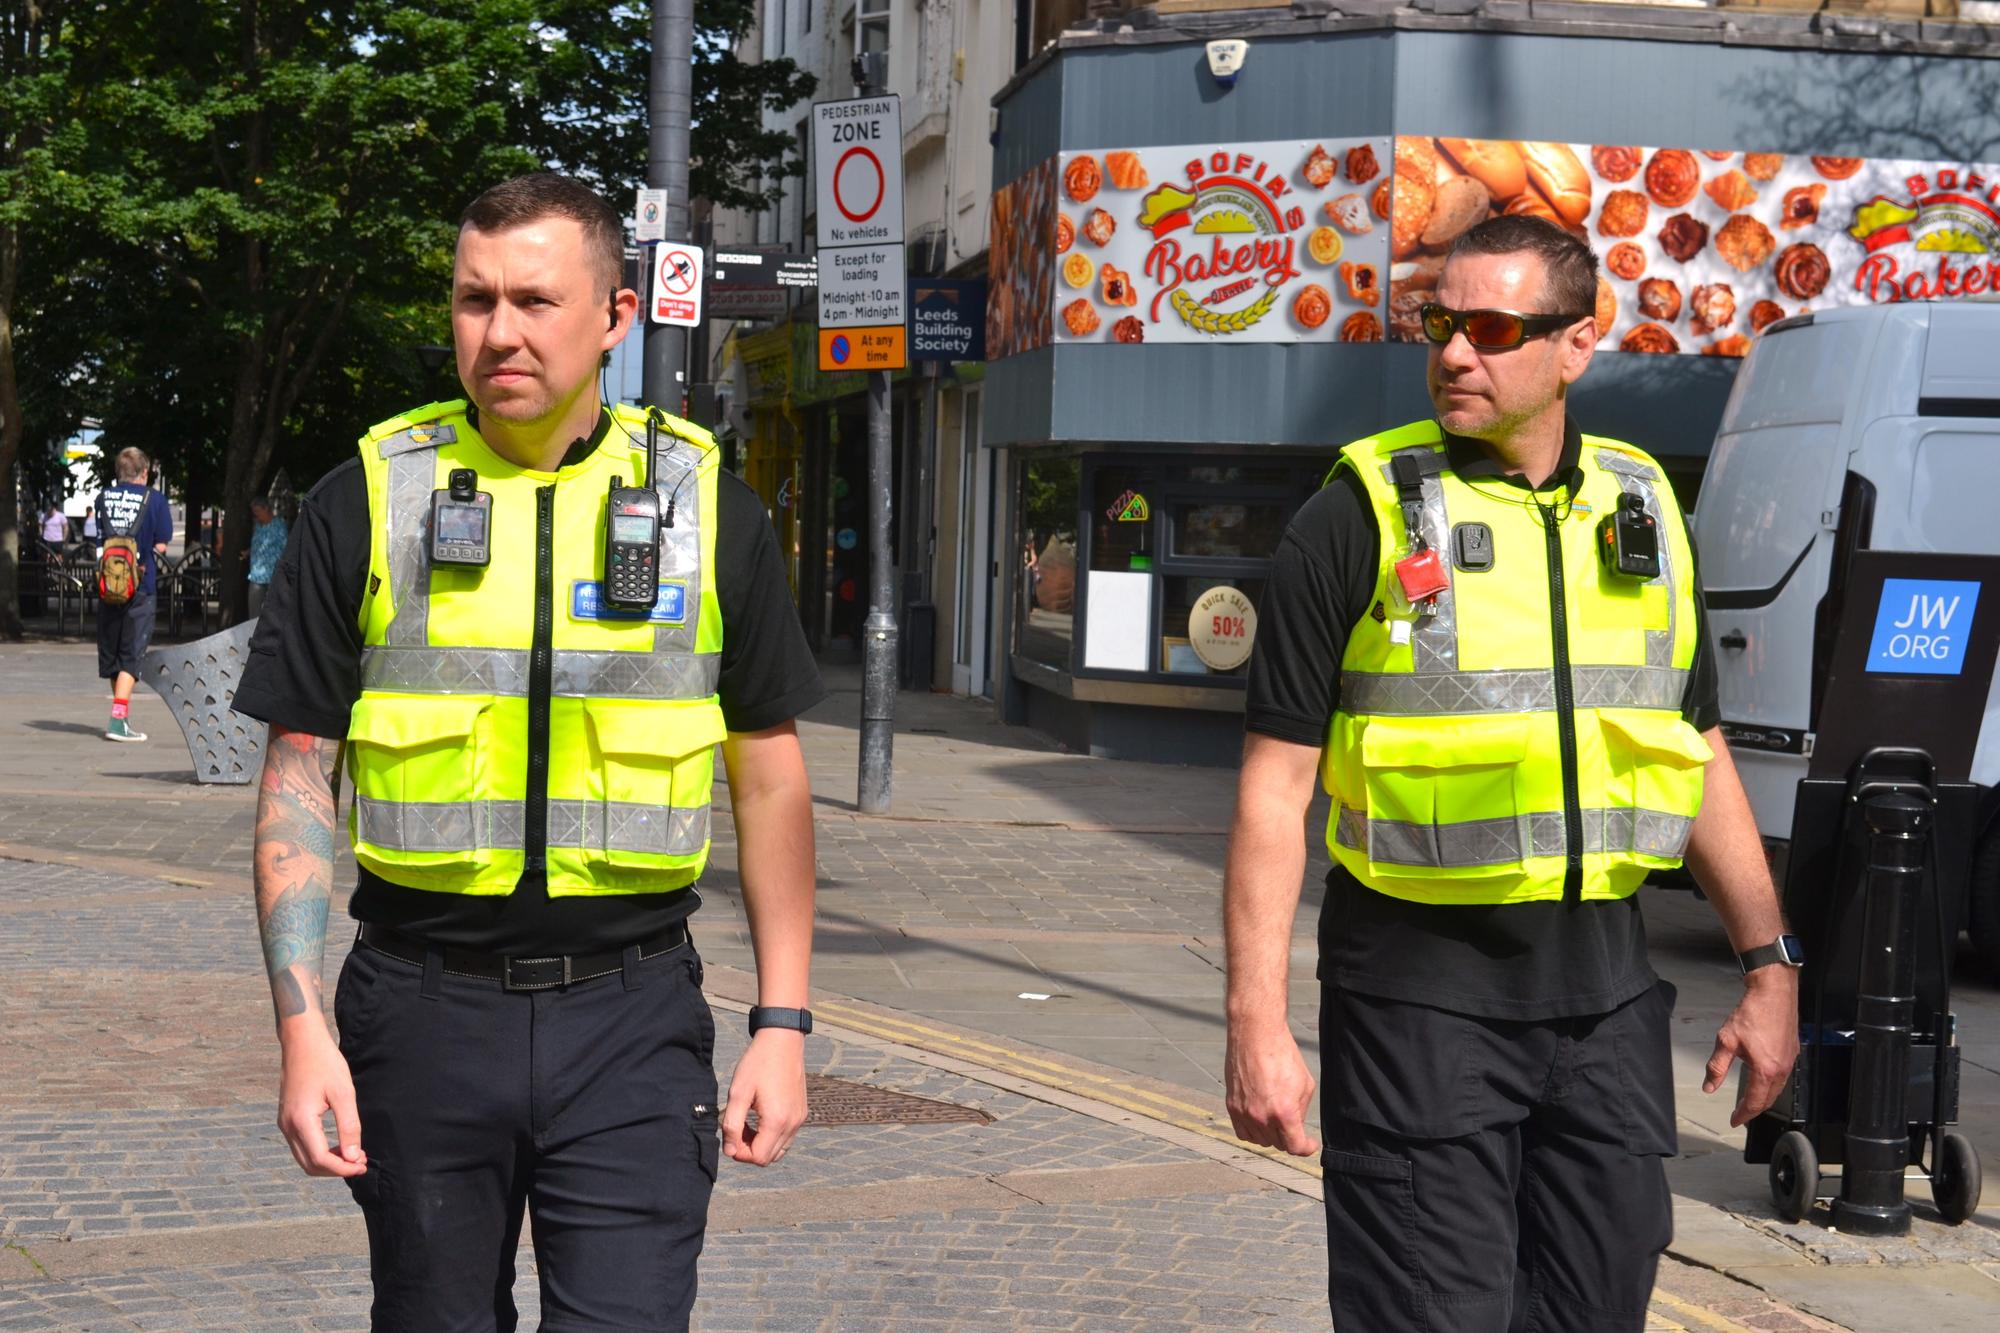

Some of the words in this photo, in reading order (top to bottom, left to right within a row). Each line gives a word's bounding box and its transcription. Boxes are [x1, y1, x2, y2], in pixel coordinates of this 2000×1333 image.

[822, 102, 890, 119] PEDESTRIAN
[832, 121, 881, 143] ZONE
[1185, 151, 1305, 231] SOFIA'S
[831, 229, 845, 240] No
[849, 226, 888, 239] vehicles
[834, 254, 868, 269] Except
[871, 253, 886, 264] for
[776, 270, 808, 278] Doncaster
[842, 269, 878, 281] loading
[1144, 235, 1301, 323] Bakery
[823, 290, 865, 304] Midnight
[884, 291, 899, 300] am
[824, 309, 830, 319] 4
[832, 311, 847, 321] pm
[855, 306, 899, 320] Midnight
[915, 308, 958, 321] Leeds
[915, 323, 972, 339] Building
[861, 335, 873, 346] At
[877, 336, 894, 347] any
[915, 337, 970, 354] Society
[866, 350, 888, 361] time
[1106, 489, 1136, 521] PIZZA
[1201, 593, 1225, 611] QUICK
[1230, 594, 1249, 614] SALE
[1893, 594, 1960, 629] JW
[1212, 615, 1245, 638] 50%
[1881, 633, 1950, 659] .ORG
